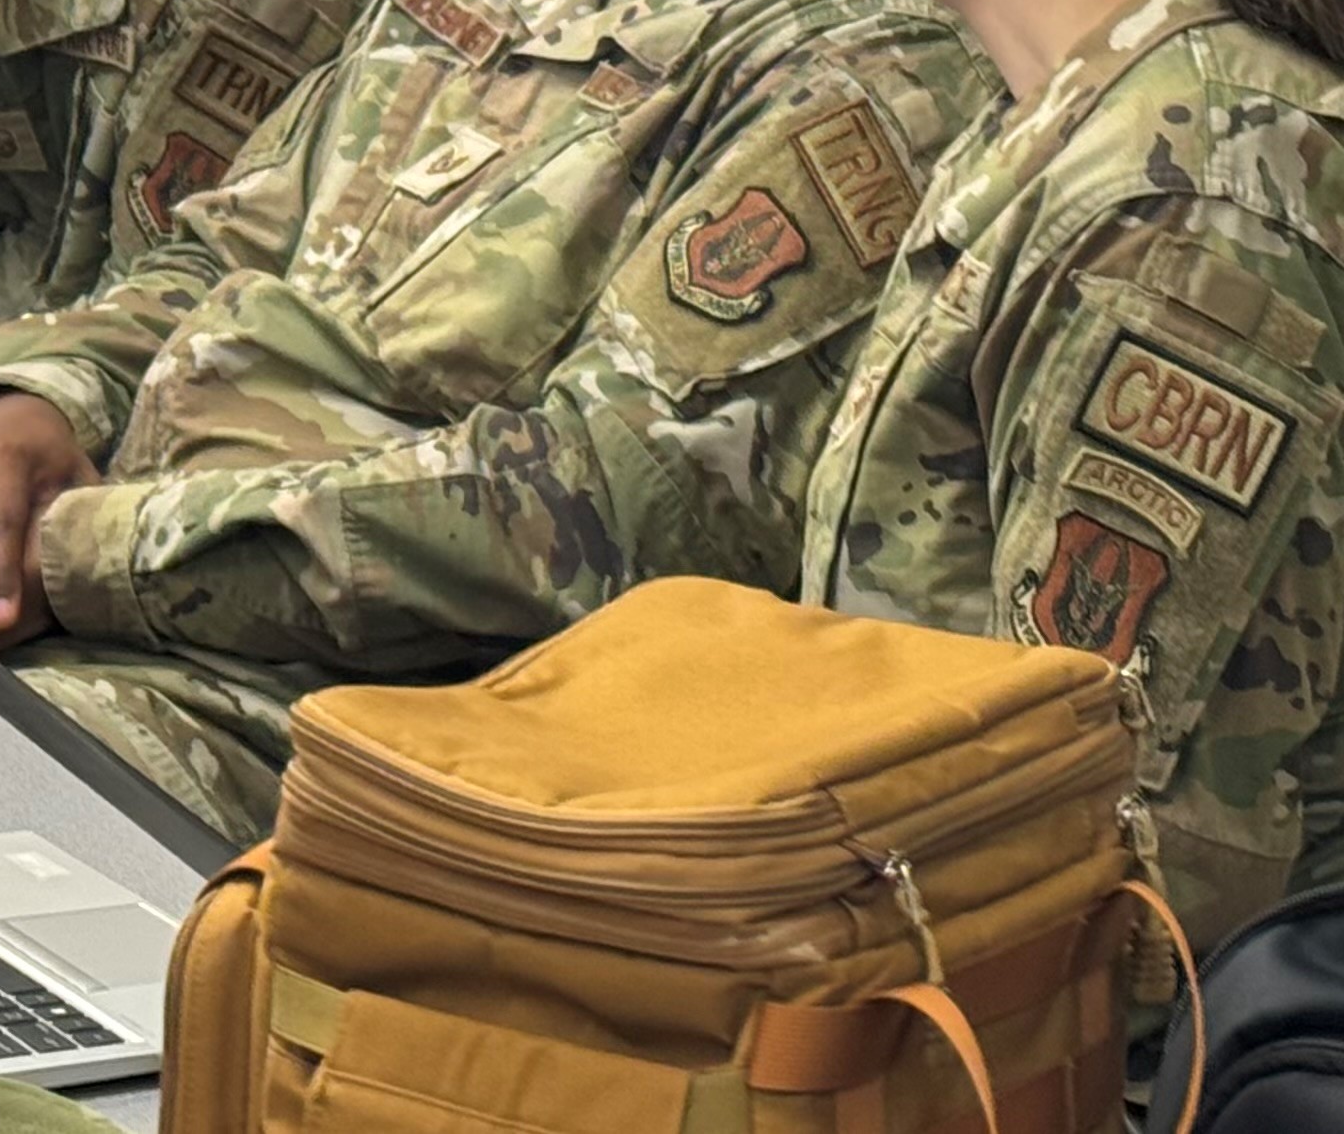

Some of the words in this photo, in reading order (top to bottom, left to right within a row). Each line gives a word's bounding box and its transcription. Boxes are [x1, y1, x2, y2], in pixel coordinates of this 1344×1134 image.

[196, 48, 285, 123] TRN
[814, 111, 913, 248] TRNG
[1103, 356, 1275, 494] CBRN
[1081, 463, 1189, 530] ARCTIC
